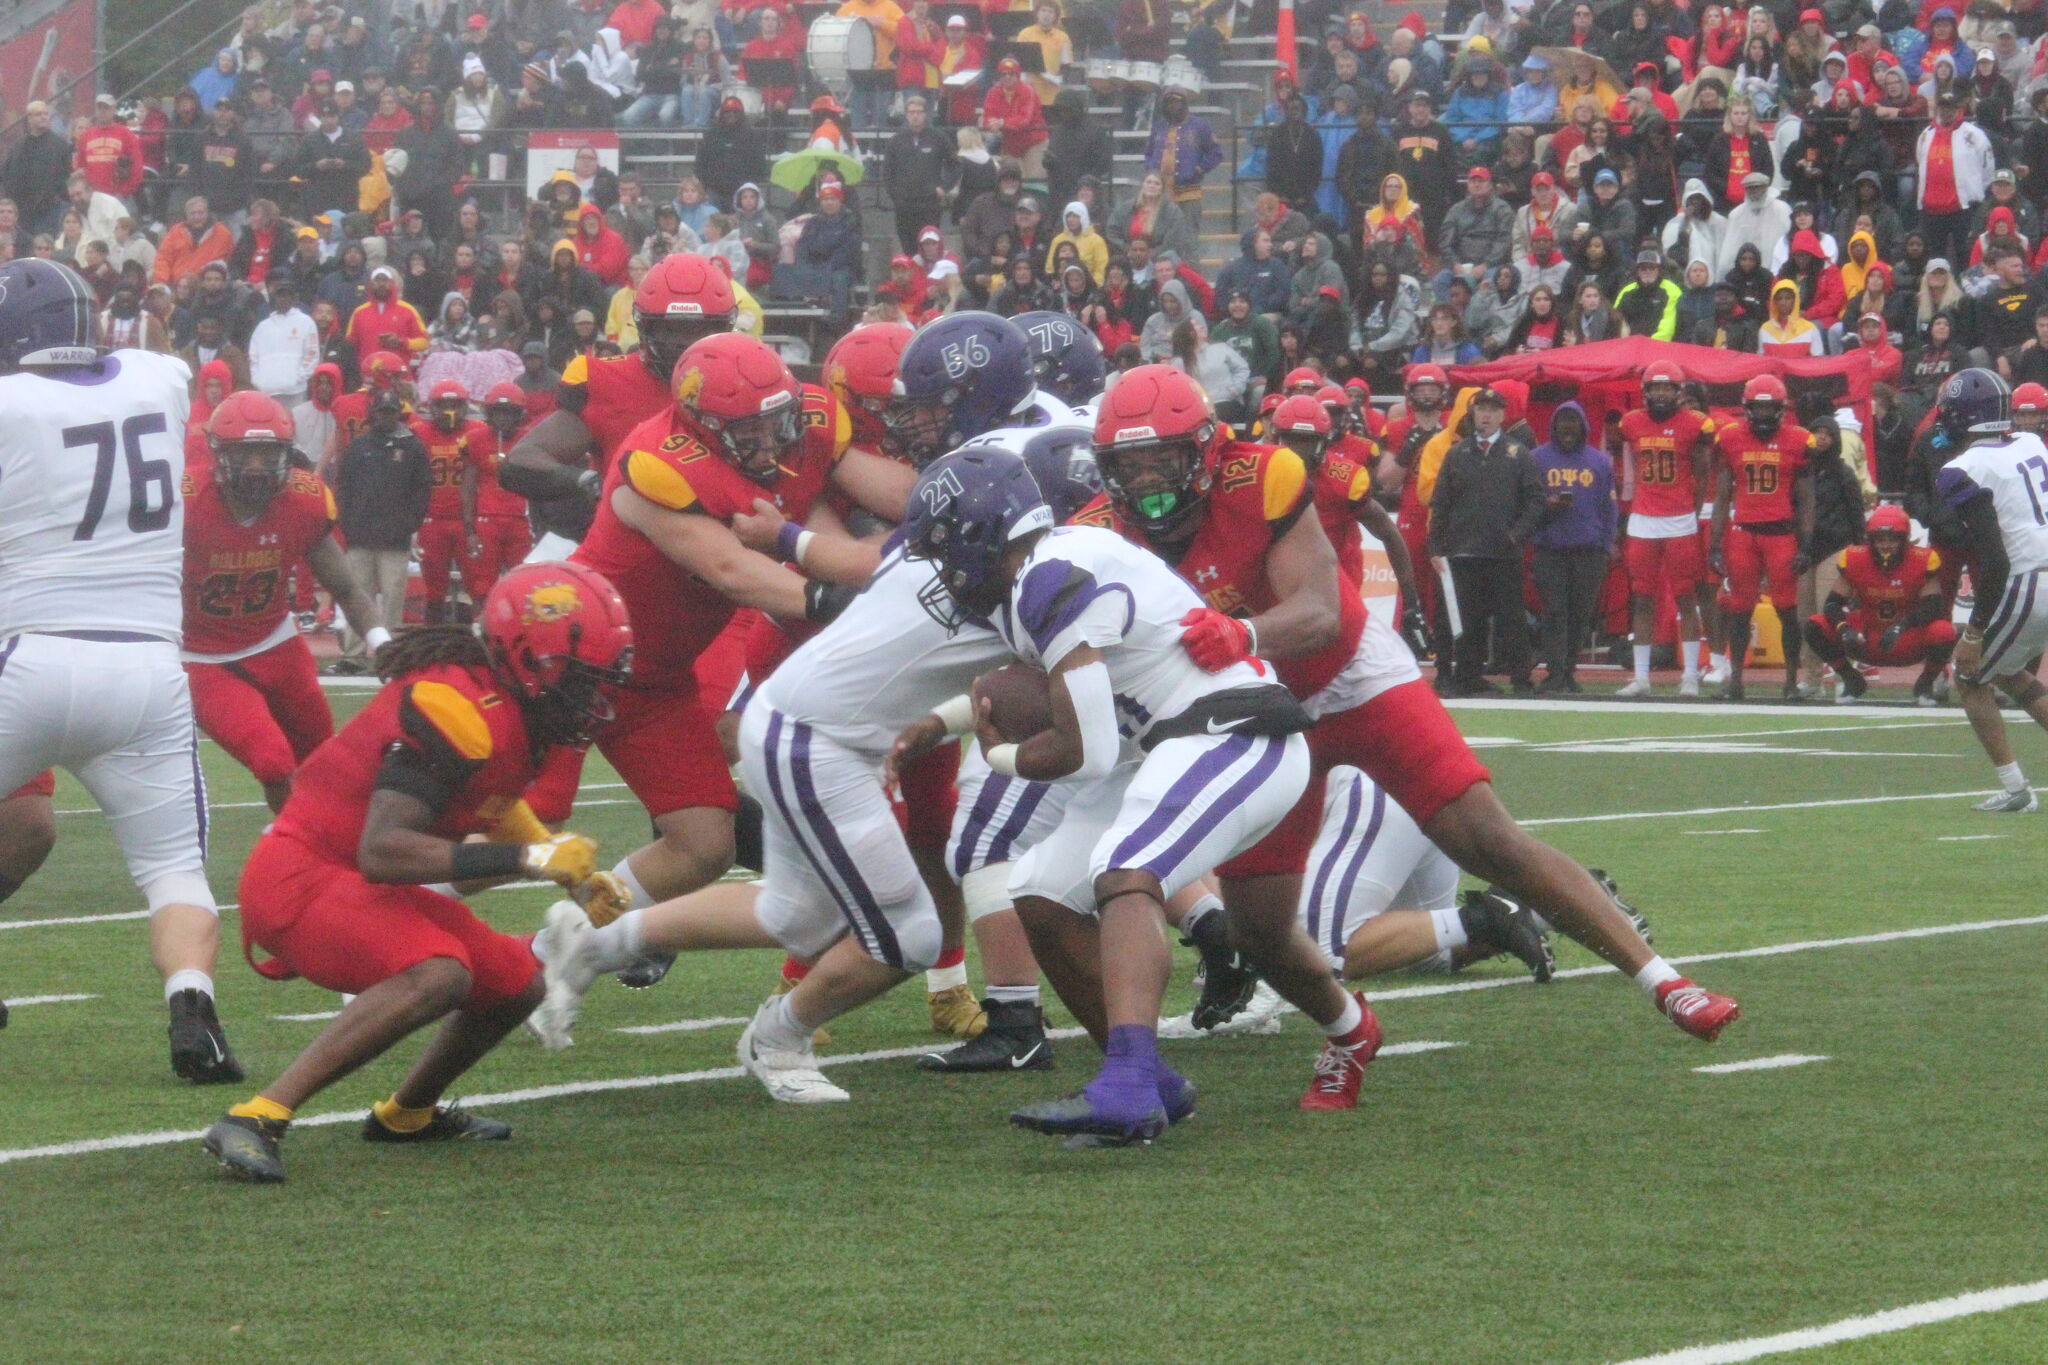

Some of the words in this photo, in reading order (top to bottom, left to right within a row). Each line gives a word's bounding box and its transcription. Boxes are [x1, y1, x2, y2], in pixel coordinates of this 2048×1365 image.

[671, 304, 698, 312] Riddell
[1028, 320, 1074, 353] 79
[941, 334, 990, 379] 56
[659, 433, 711, 465] 97
[1118, 428, 1150, 439] Riddell
[62, 412, 174, 541] 76
[1223, 454, 1262, 493] 12
[1640, 448, 1676, 485] 30
[1744, 462, 1779, 494] 10
[920, 467, 964, 517] 21
[199, 567, 281, 615] 23
